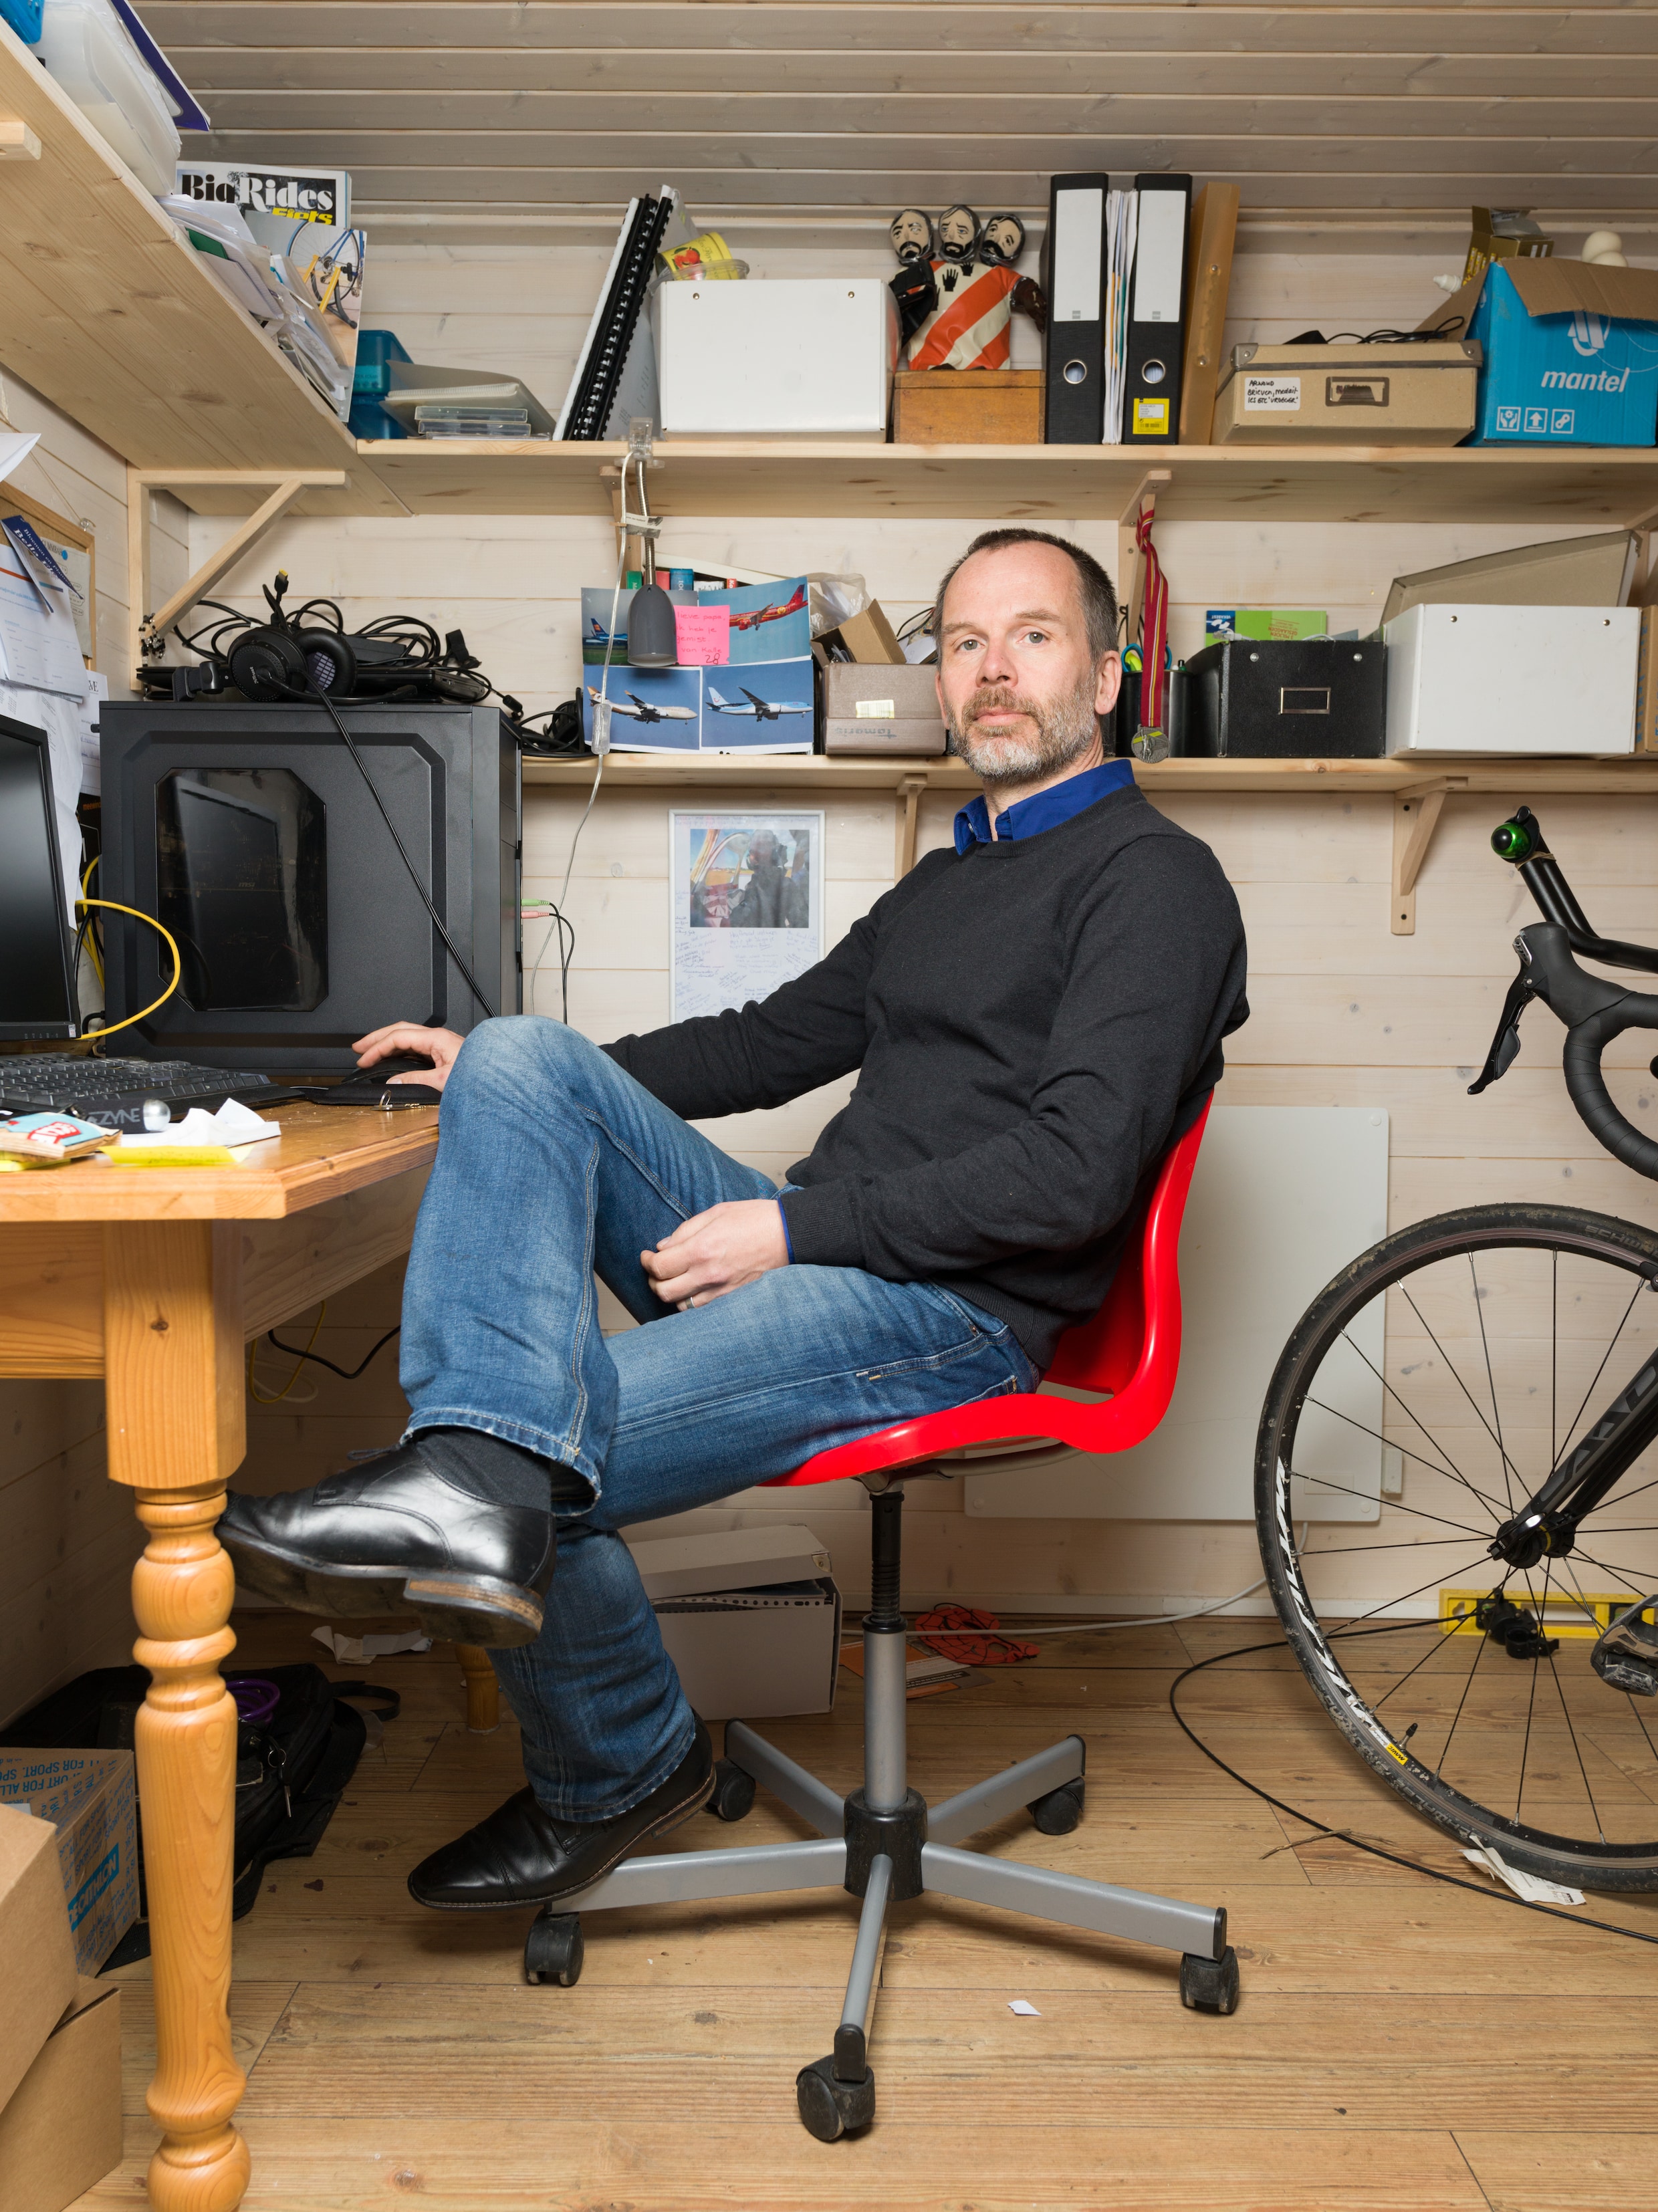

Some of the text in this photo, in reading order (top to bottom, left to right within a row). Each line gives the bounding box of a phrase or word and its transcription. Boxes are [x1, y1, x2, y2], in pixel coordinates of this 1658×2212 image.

[182, 174, 334, 213] Big Rides
[1541, 367, 1630, 392] mantel
[677, 611, 699, 619] lieve
[705, 652, 721, 664] 28
[835, 727, 897, 739] tamaris
[1387, 1745, 1405, 1761] MAVIC
[23, 1761, 60, 1778] SPORT.
[0, 1782, 19, 1796] ALL
[23, 1779, 44, 1792] FOR
